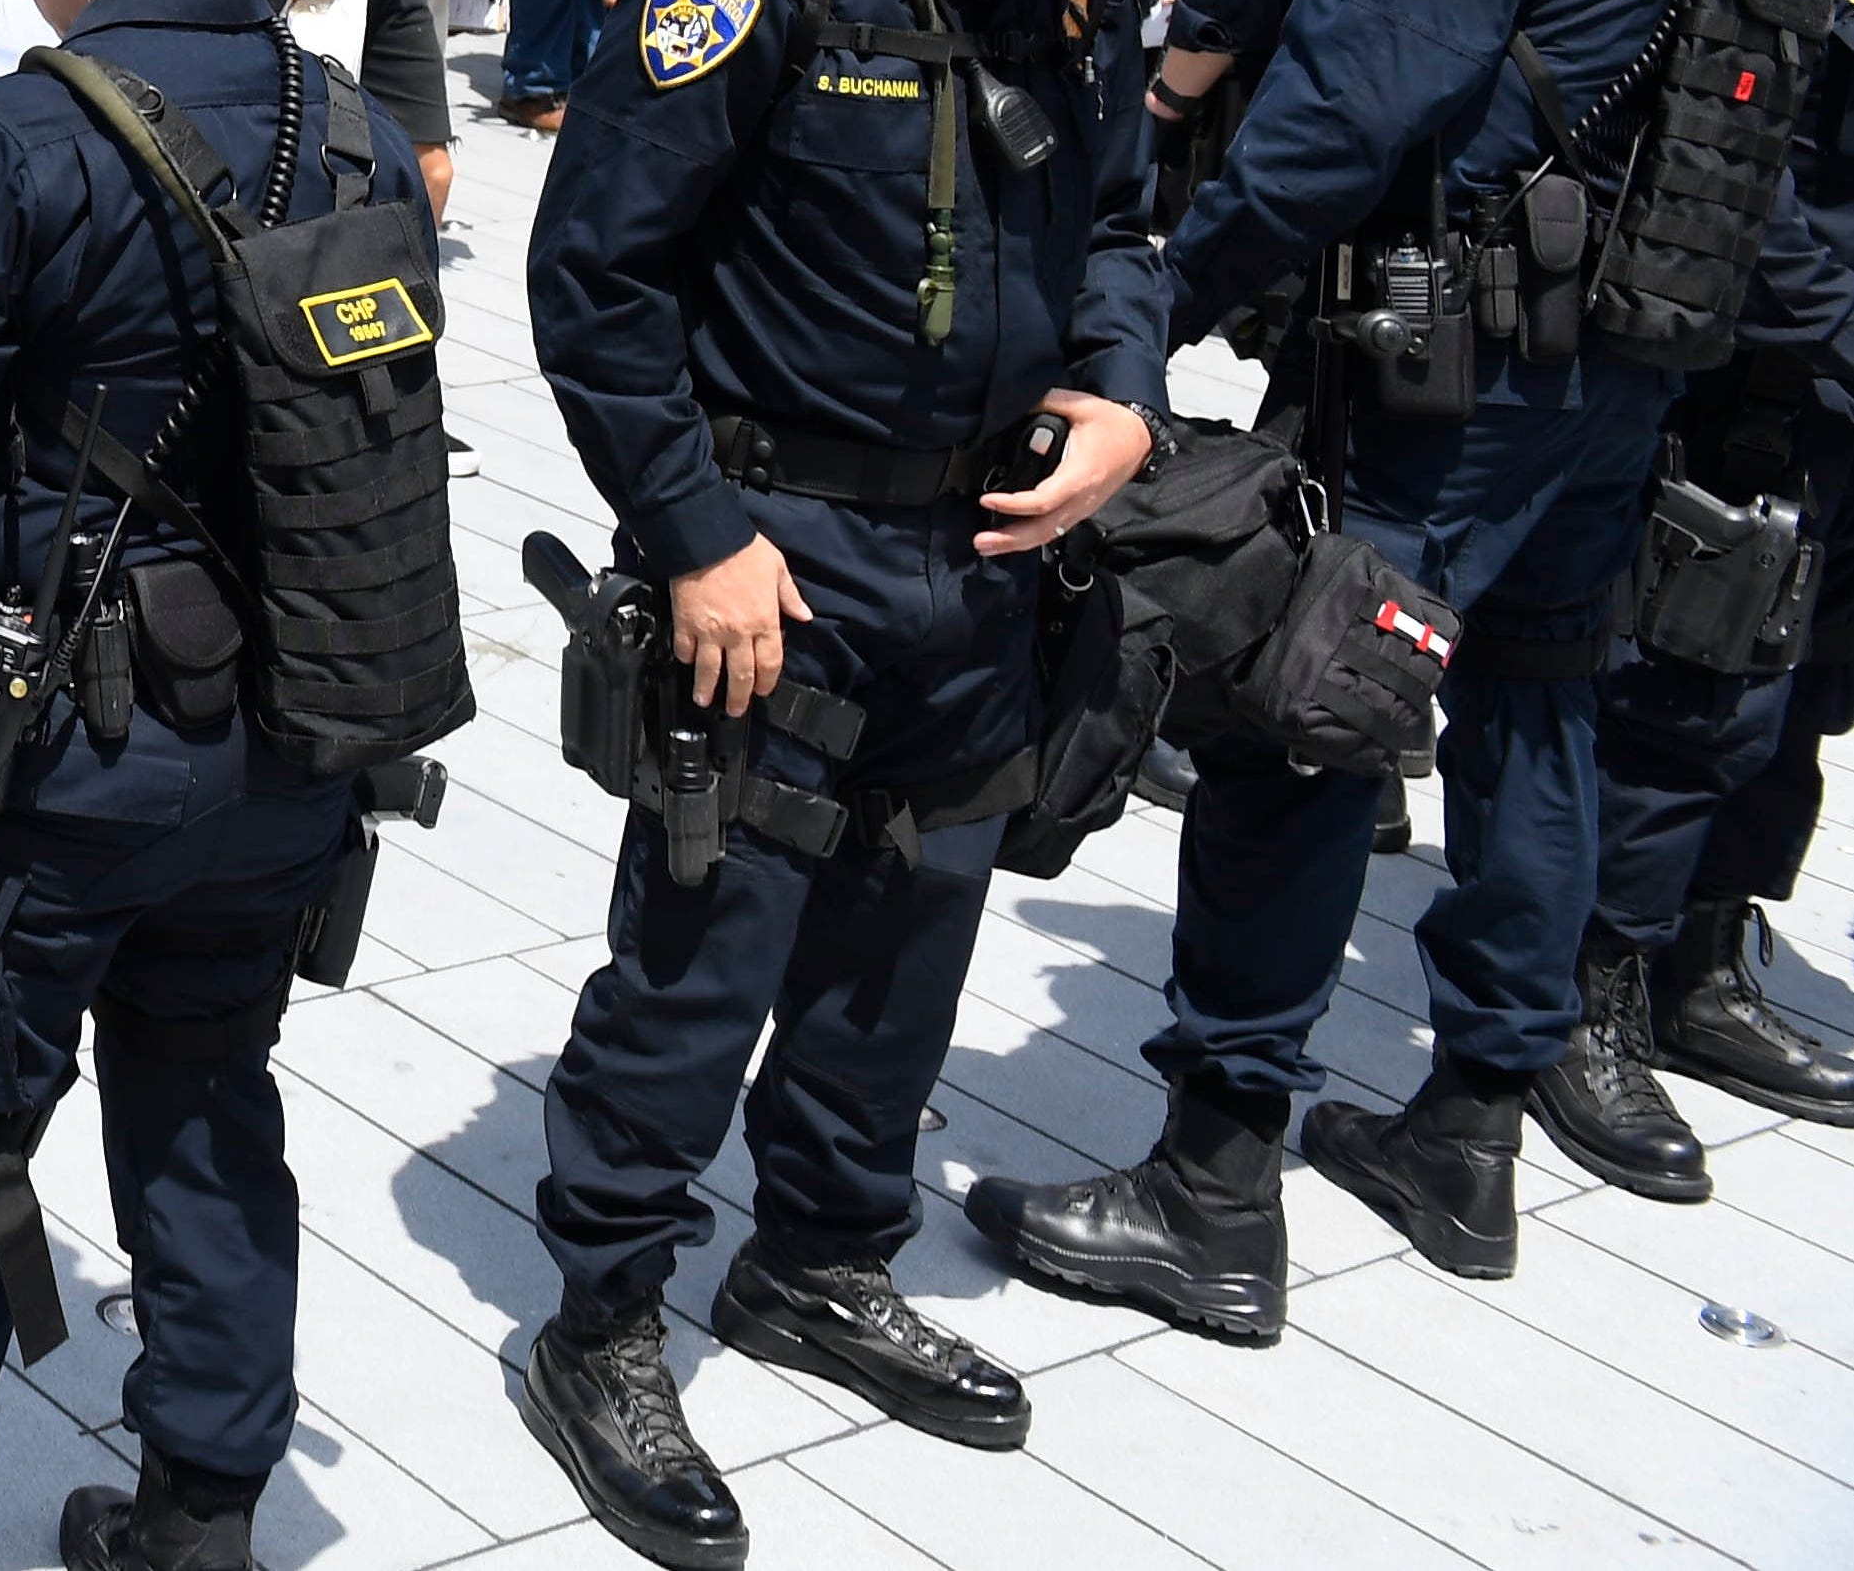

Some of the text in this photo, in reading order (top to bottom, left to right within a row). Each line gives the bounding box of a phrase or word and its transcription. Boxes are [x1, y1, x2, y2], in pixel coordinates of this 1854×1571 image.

[818, 76, 919, 98] S. BUCHANAN
[336, 297, 377, 324] CHP
